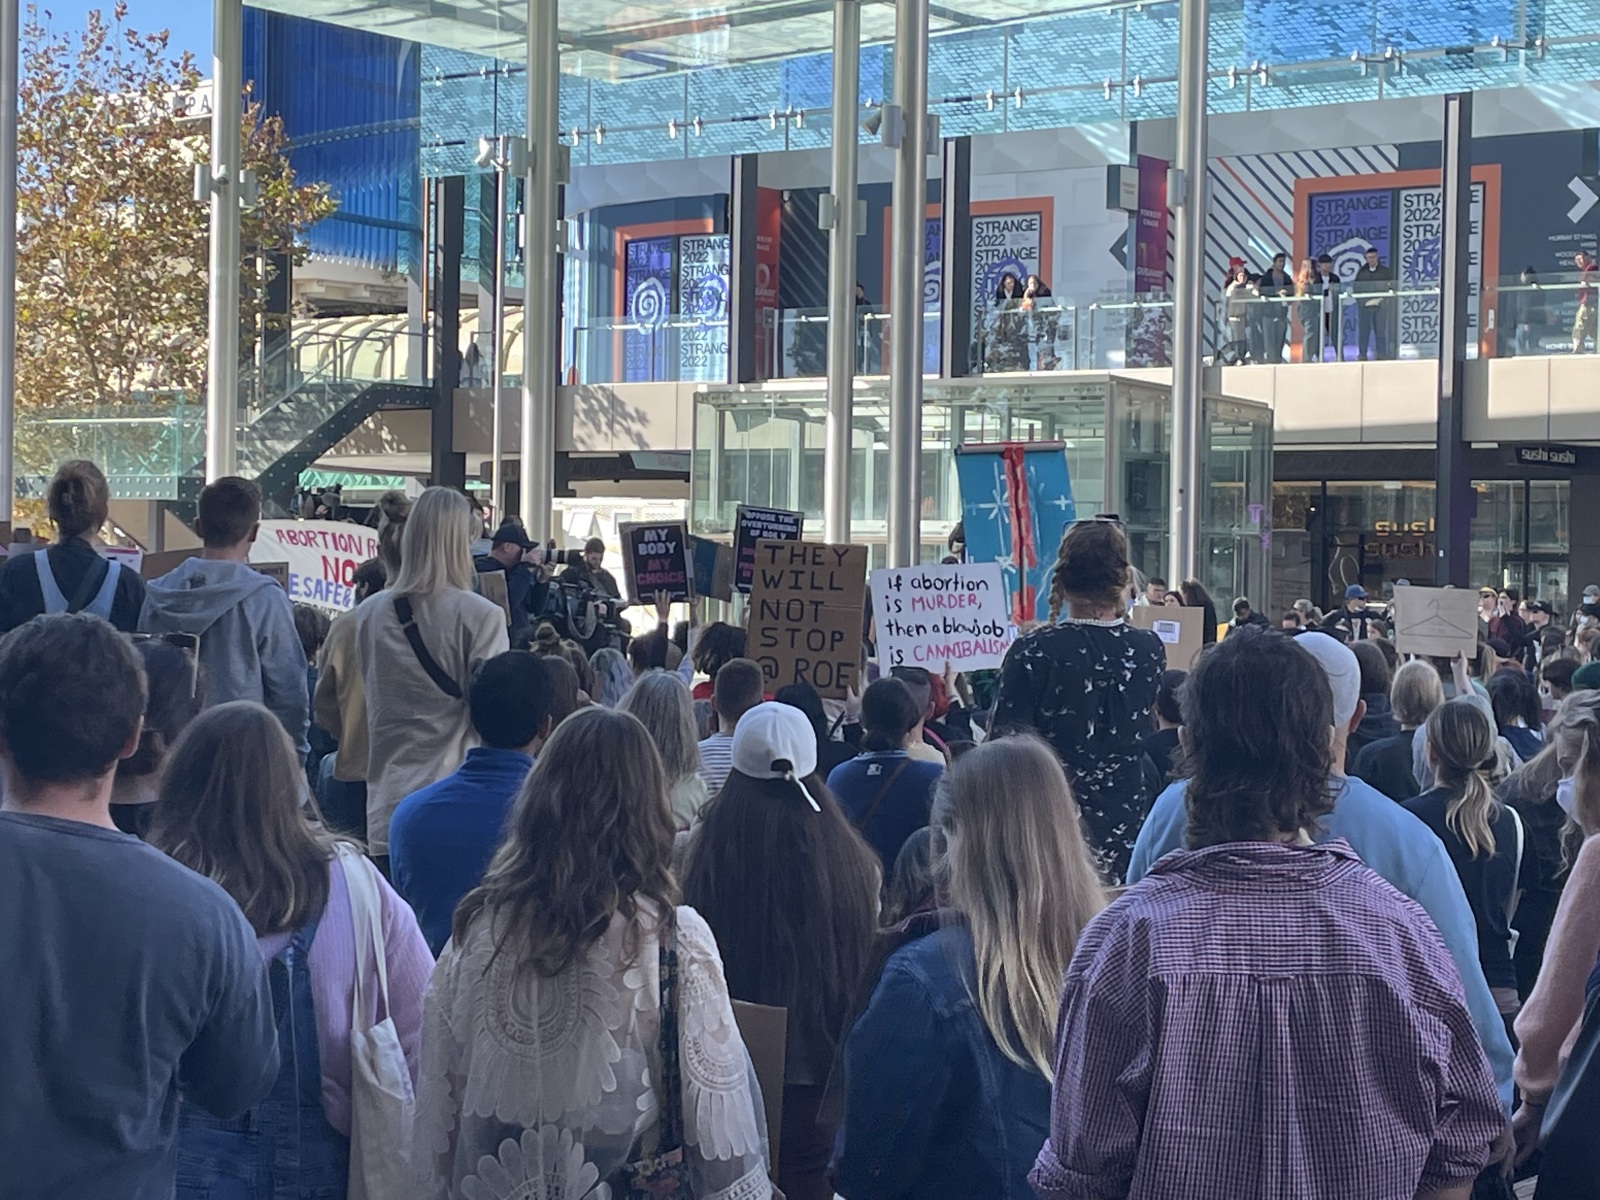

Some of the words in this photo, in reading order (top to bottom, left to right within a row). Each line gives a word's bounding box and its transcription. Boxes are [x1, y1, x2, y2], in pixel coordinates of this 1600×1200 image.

[1315, 195, 1389, 214] STRANGE
[1315, 213, 1350, 228] 2022
[1403, 207, 1441, 222] 2022
[975, 218, 1038, 235] STRANGE
[975, 233, 1006, 248] 2022
[1314, 226, 1388, 244] STRANGE
[682, 237, 730, 252] STRANG
[682, 251, 709, 264] 2022
[974, 246, 1038, 262] STRANGE
[682, 263, 730, 278] STRANG
[681, 342, 729, 355] STRANG
[682, 355, 708, 368] 2022
[745, 511, 776, 522] OPPOSE
[778, 514, 795, 524] THE
[741, 519, 798, 532] OVERTURNING
[275, 528, 363, 557] ABORTION
[644, 528, 668, 542] MY
[637, 541, 677, 555] BODY
[763, 544, 850, 567] THEY
[647, 558, 672, 571] MY
[637, 571, 686, 585] CHOICE
[761, 569, 845, 591] WILL
[888, 574, 903, 592] If
[911, 572, 989, 592] abortion
[760, 598, 825, 623] NOT
[885, 595, 903, 613] is
[911, 593, 983, 613] MURDER,
[885, 618, 927, 637] then
[942, 616, 1005, 638] blowjob
[760, 627, 845, 652] STOP
[889, 645, 904, 665] is
[913, 637, 1011, 662] CANNIBALISM
[794, 658, 856, 688] ROE
